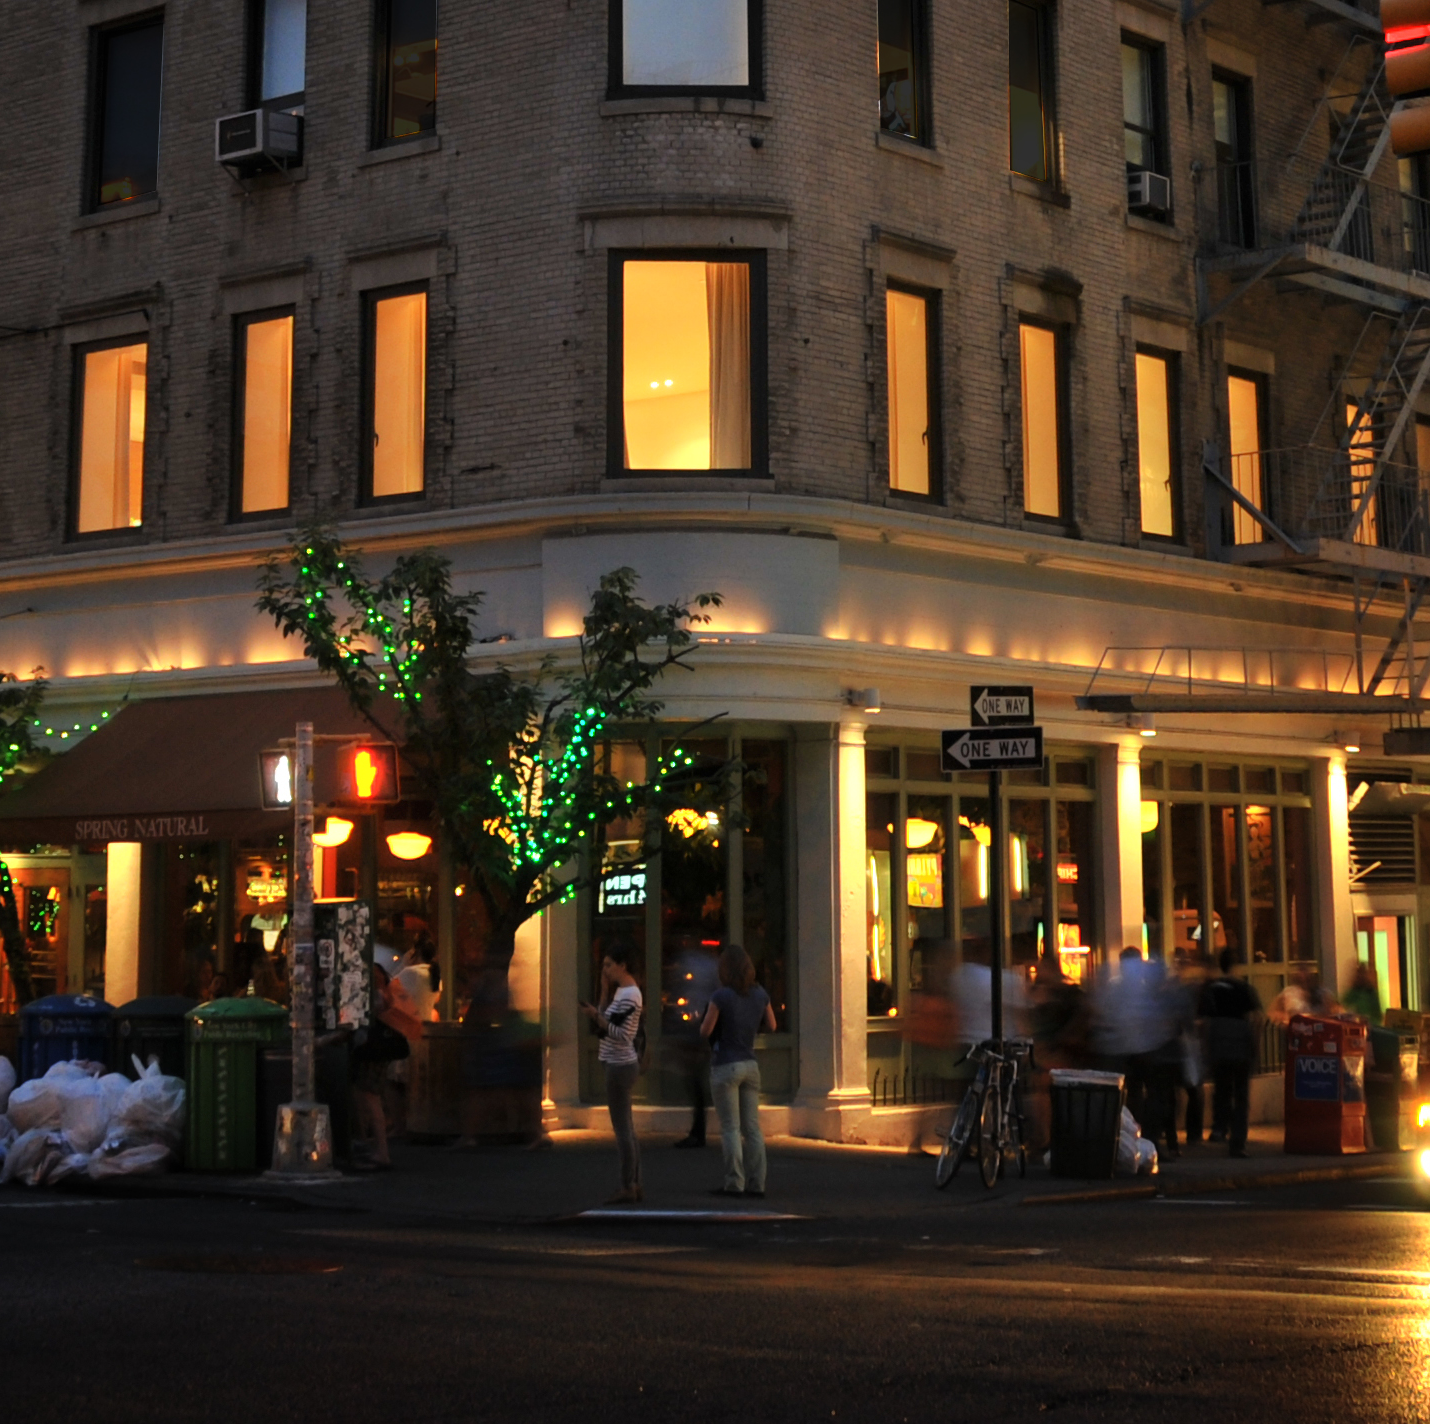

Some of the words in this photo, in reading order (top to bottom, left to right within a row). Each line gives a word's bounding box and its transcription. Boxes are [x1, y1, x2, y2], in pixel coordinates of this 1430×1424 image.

[981, 698, 1001, 714] ONE
[1005, 698, 1025, 714] WAY
[960, 742, 991, 758] ONE
[999, 740, 1029, 756] WAY
[75, 819, 128, 840] SPRING
[134, 816, 209, 838] NATURAL
[1298, 1058, 1337, 1074] VOICE
